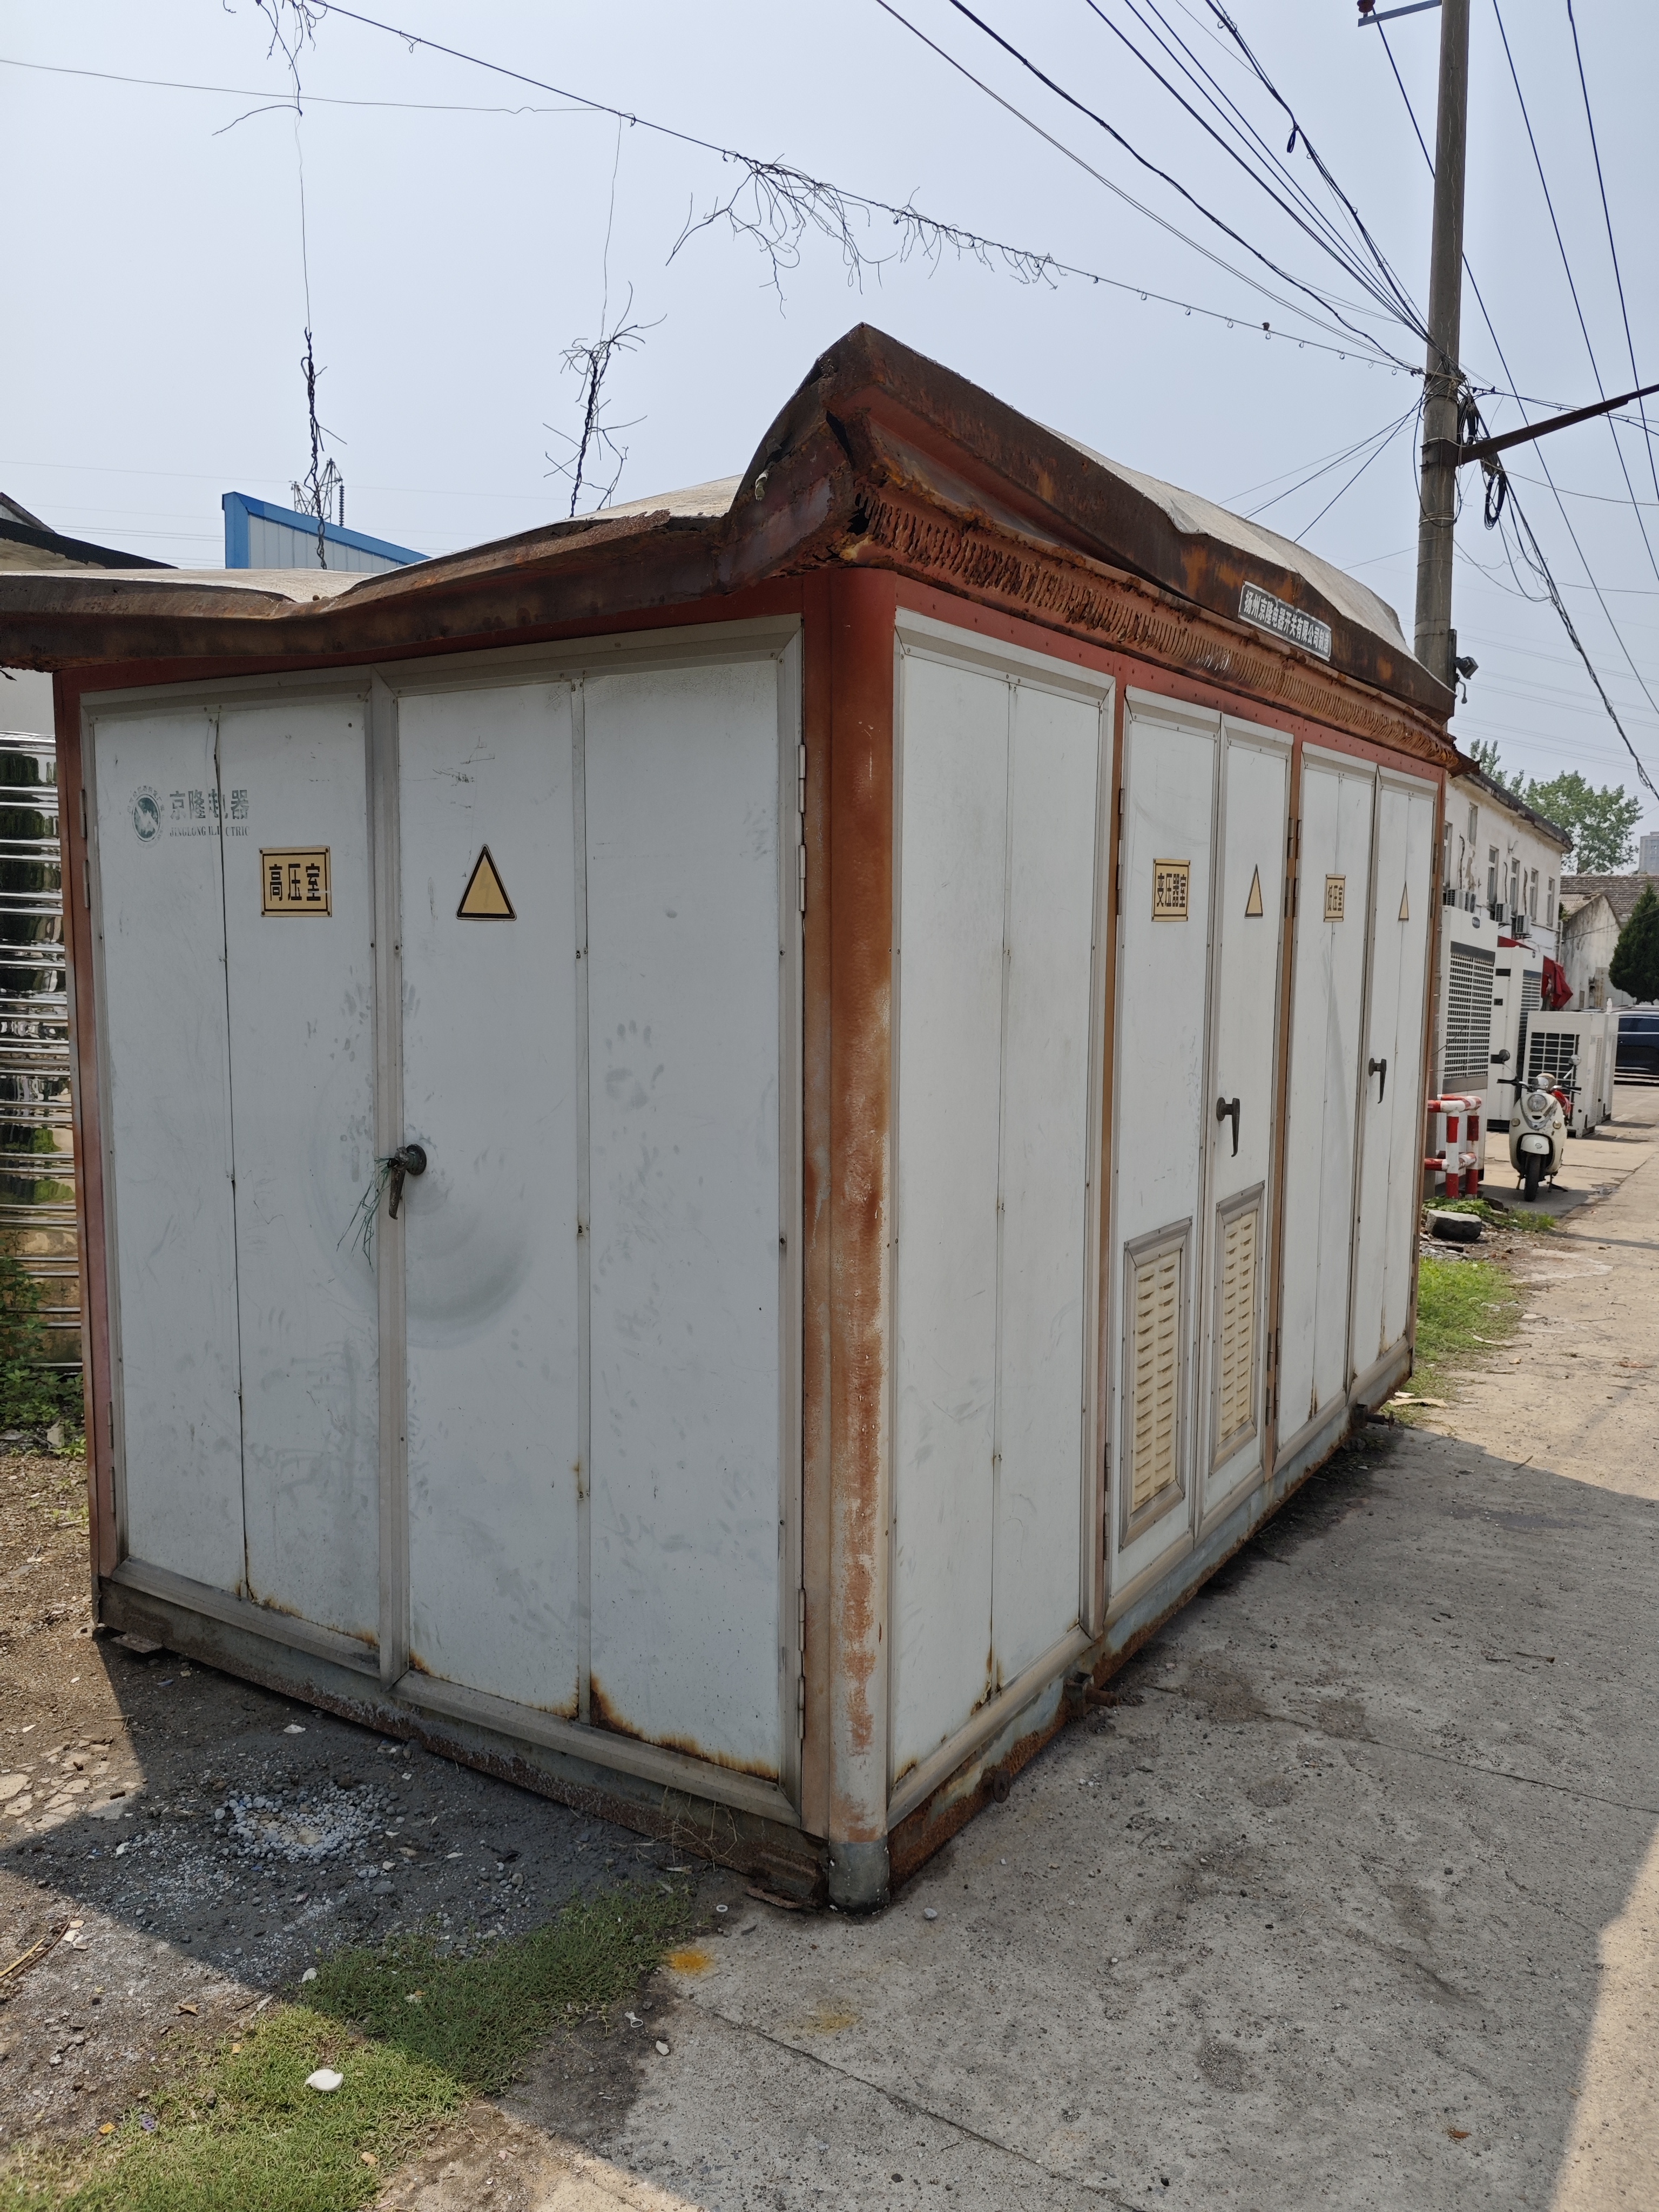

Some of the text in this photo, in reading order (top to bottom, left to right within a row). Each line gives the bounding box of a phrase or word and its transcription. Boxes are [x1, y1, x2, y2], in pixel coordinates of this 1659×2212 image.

[1244, 590, 1329, 653] 扬州京隆电器开关有限公司制造
[269, 863, 321, 901] 高压室
[1156, 873, 1186, 907] 变压器室
[1327, 885, 1343, 911] 低压室
